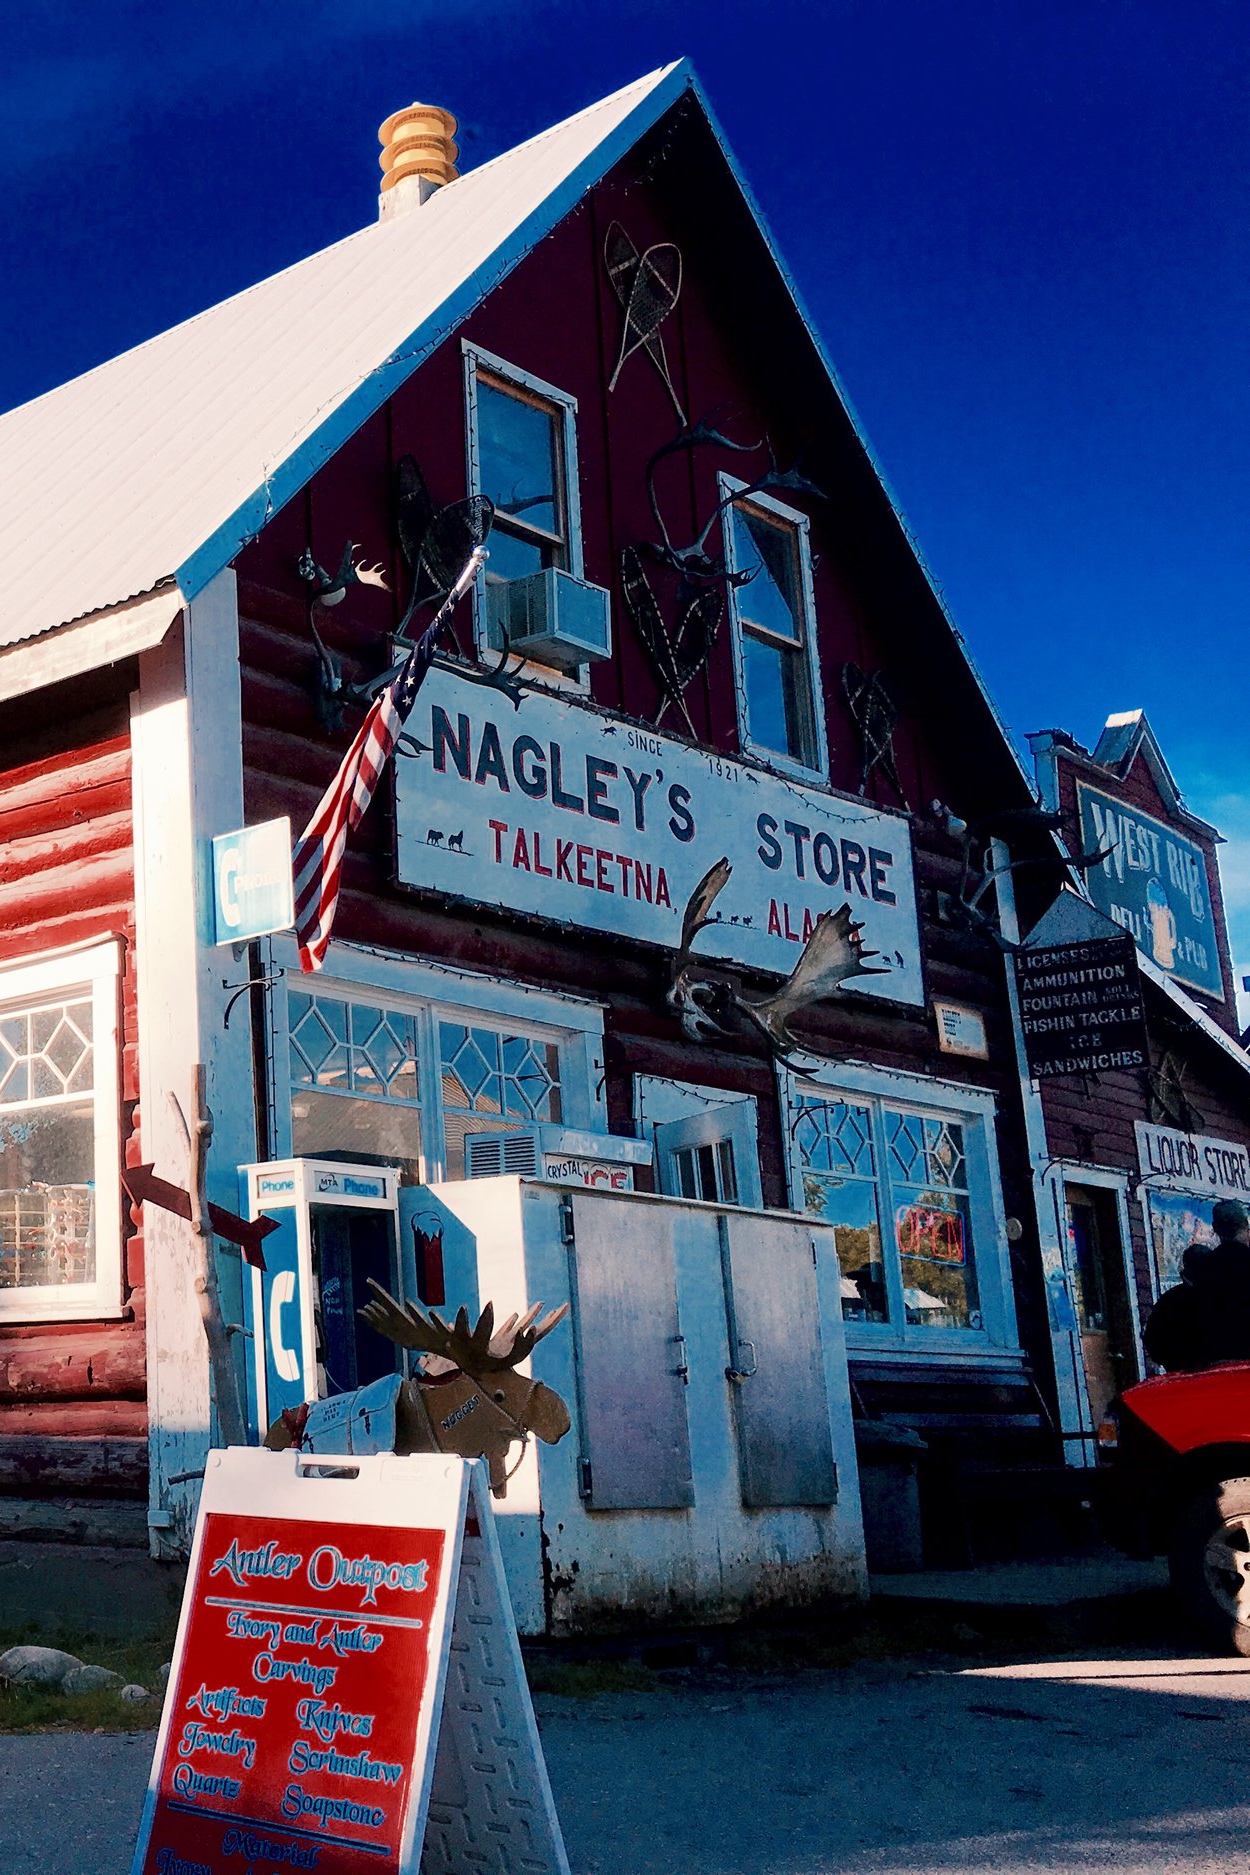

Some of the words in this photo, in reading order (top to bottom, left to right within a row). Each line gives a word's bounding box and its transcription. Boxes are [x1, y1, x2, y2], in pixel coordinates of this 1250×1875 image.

[708, 757, 740, 783] 1921
[757, 813, 897, 906] STORE
[1091, 802, 1160, 884] WEST
[1166, 840, 1205, 923] RIB
[488, 819, 679, 914] TALKEETNA,
[768, 898, 863, 952] ALA
[1017, 948, 1089, 970] LICENSES
[1184, 936, 1208, 971] PUB
[1023, 964, 1126, 991] AMMUNITION
[1022, 991, 1098, 1013] FOUNTAIN
[1023, 1015, 1075, 1034] FISHIN
[1078, 1006, 1141, 1026] TACKLE
[1032, 1050, 1143, 1076] SANDWICHES
[547, 1160, 583, 1180] CRYSTAL
[582, 1161, 629, 1190] ICE
[1145, 1132, 1203, 1181] LIQUOR
[1204, 1146, 1250, 1193] STORE
[261, 1180, 295, 1193] Phone
[320, 1177, 339, 1188] MTA
[343, 1177, 380, 1196] Phone
[896, 1206, 965, 1264] OPEN
[441, 1394, 481, 1433] NUGGET
[210, 1538, 302, 1586] Antler
[307, 1545, 429, 1608] Outpost
[282, 1620, 317, 1646] and
[319, 1621, 384, 1656] Antler
[252, 1653, 338, 1694] Carvings
[295, 1699, 375, 1741] Knives
[287, 1741, 403, 1787] Scrimshaw
[172, 1762, 241, 1800] Quartz
[280, 1784, 386, 1829] Soapstone
